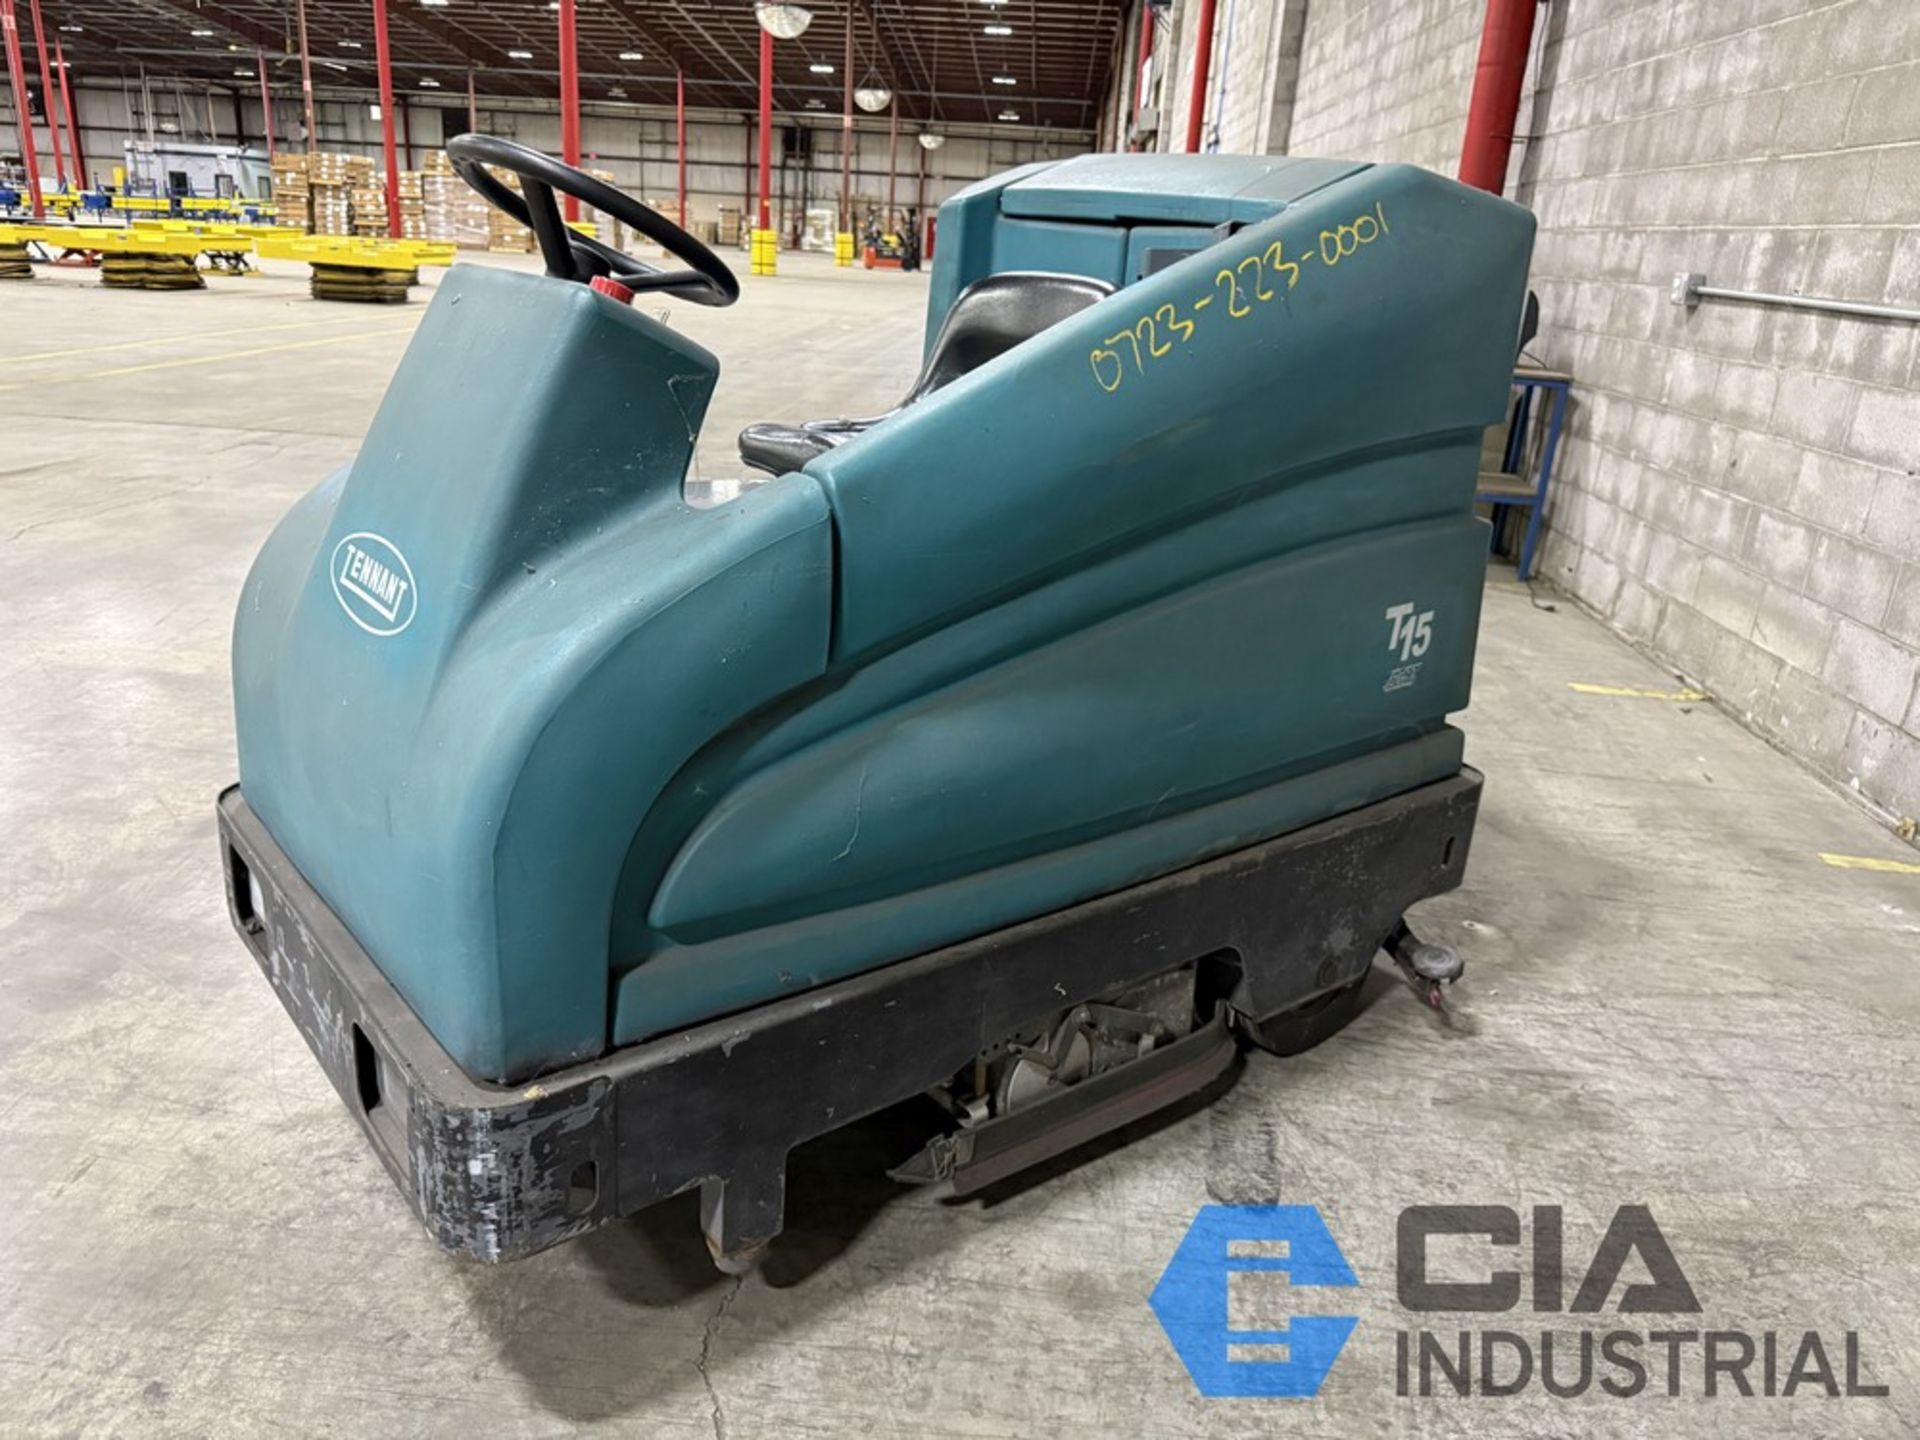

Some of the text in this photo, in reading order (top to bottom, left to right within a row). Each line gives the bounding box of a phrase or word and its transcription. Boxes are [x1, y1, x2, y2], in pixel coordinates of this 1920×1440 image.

[1090, 201, 1389, 391] 0723-223-0001
[340, 544, 408, 622] TENNANT
[1385, 602, 1435, 661] T15
